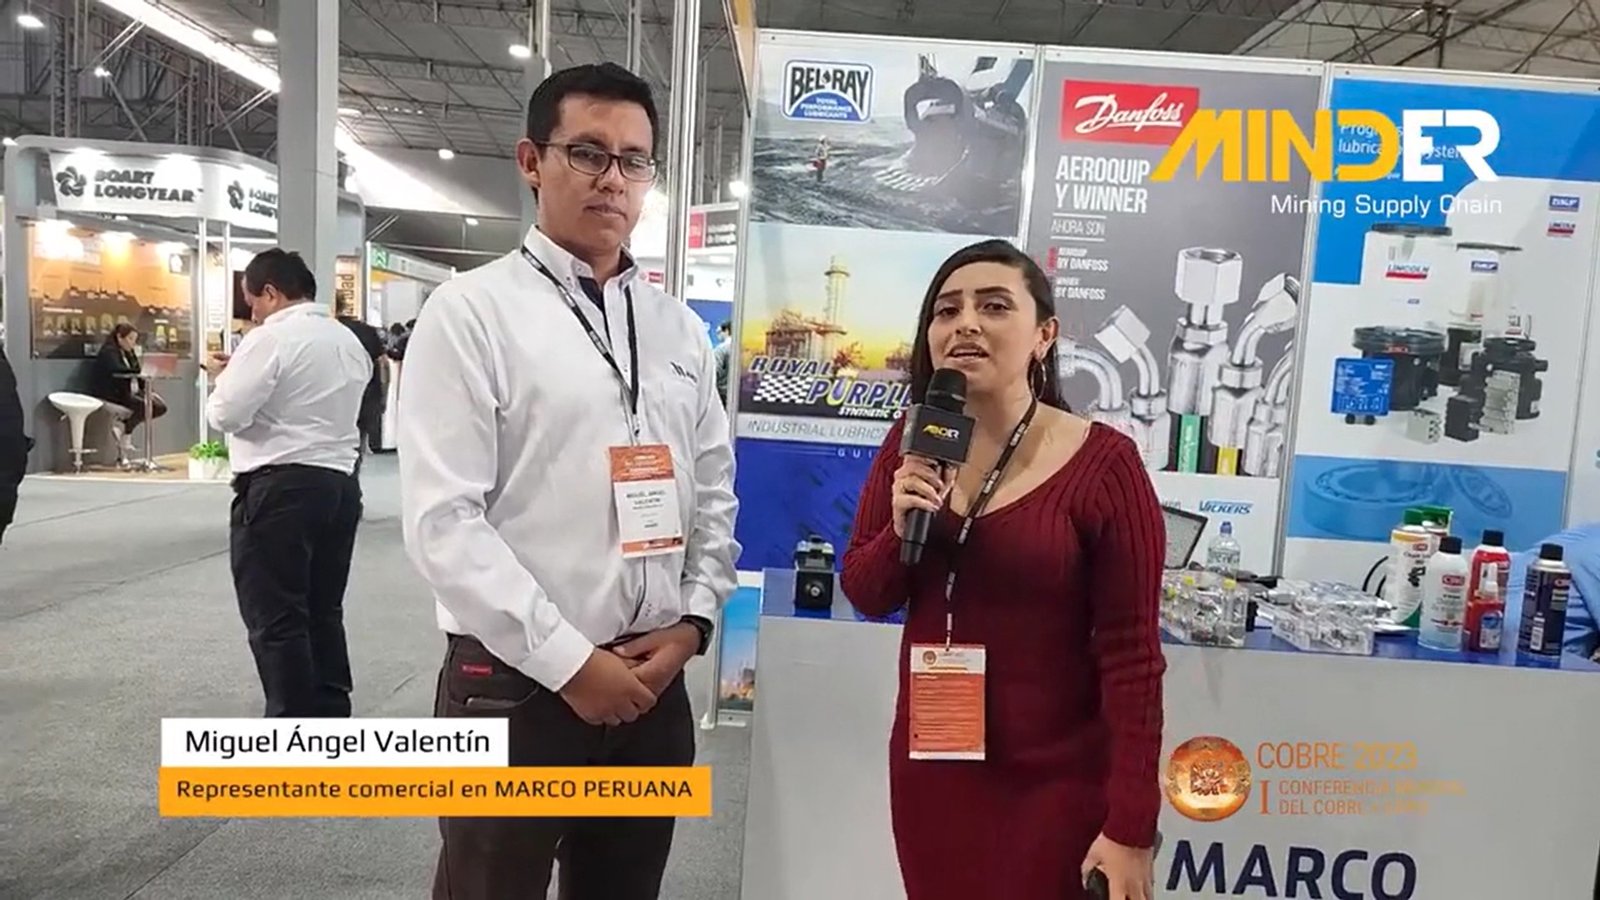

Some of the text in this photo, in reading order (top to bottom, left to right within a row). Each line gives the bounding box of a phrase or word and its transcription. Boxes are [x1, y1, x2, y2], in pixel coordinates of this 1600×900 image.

[1074, 92, 1184, 132] Danfoss
[95, 169, 154, 184] BOART
[1055, 155, 1150, 184] AEROQUIP
[94, 184, 195, 202] LONGYEAR
[1055, 184, 1148, 213] Y WINNER
[1051, 219, 1084, 234] AHORA
[1069, 257, 1109, 272] DANFOSS
[1067, 286, 1106, 300] DANFOSS
[749, 356, 834, 376] ROYAL
[838, 407, 903, 419] SYNTHETIC O
[748, 420, 829, 436] INDUSTRIAL
[1165, 839, 1418, 900] MARCO
